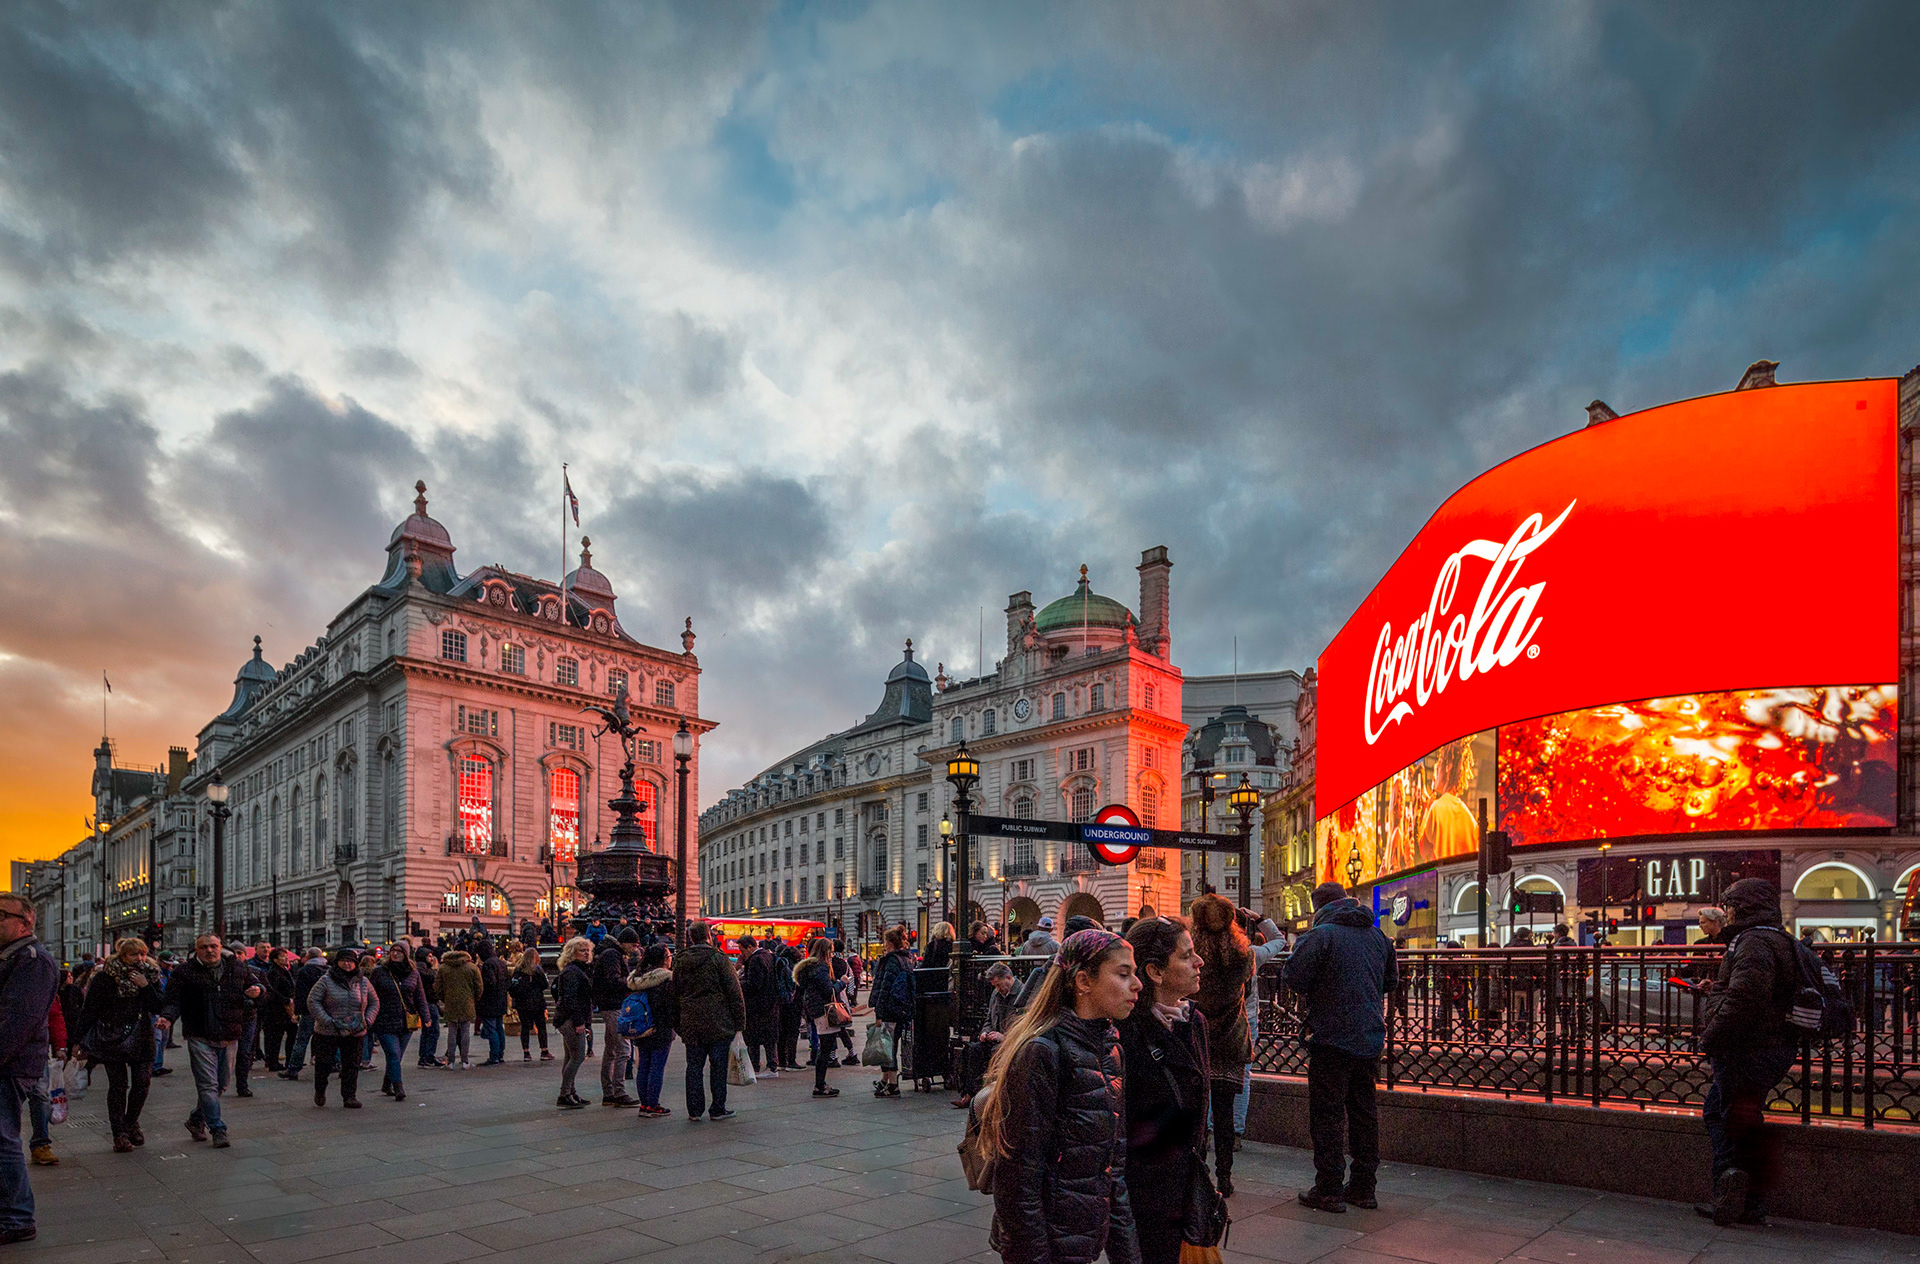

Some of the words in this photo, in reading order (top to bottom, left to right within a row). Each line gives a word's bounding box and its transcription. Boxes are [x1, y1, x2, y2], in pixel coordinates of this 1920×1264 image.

[1001, 823, 1022, 832] PUBLIC
[1023, 825, 1047, 833] SUBWAY
[1084, 828, 1150, 841] UNDERGROUND
[1178, 837, 1197, 845] PUBLIC
[1196, 838, 1218, 846] SUBWAY
[1647, 858, 1705, 897] GAP
